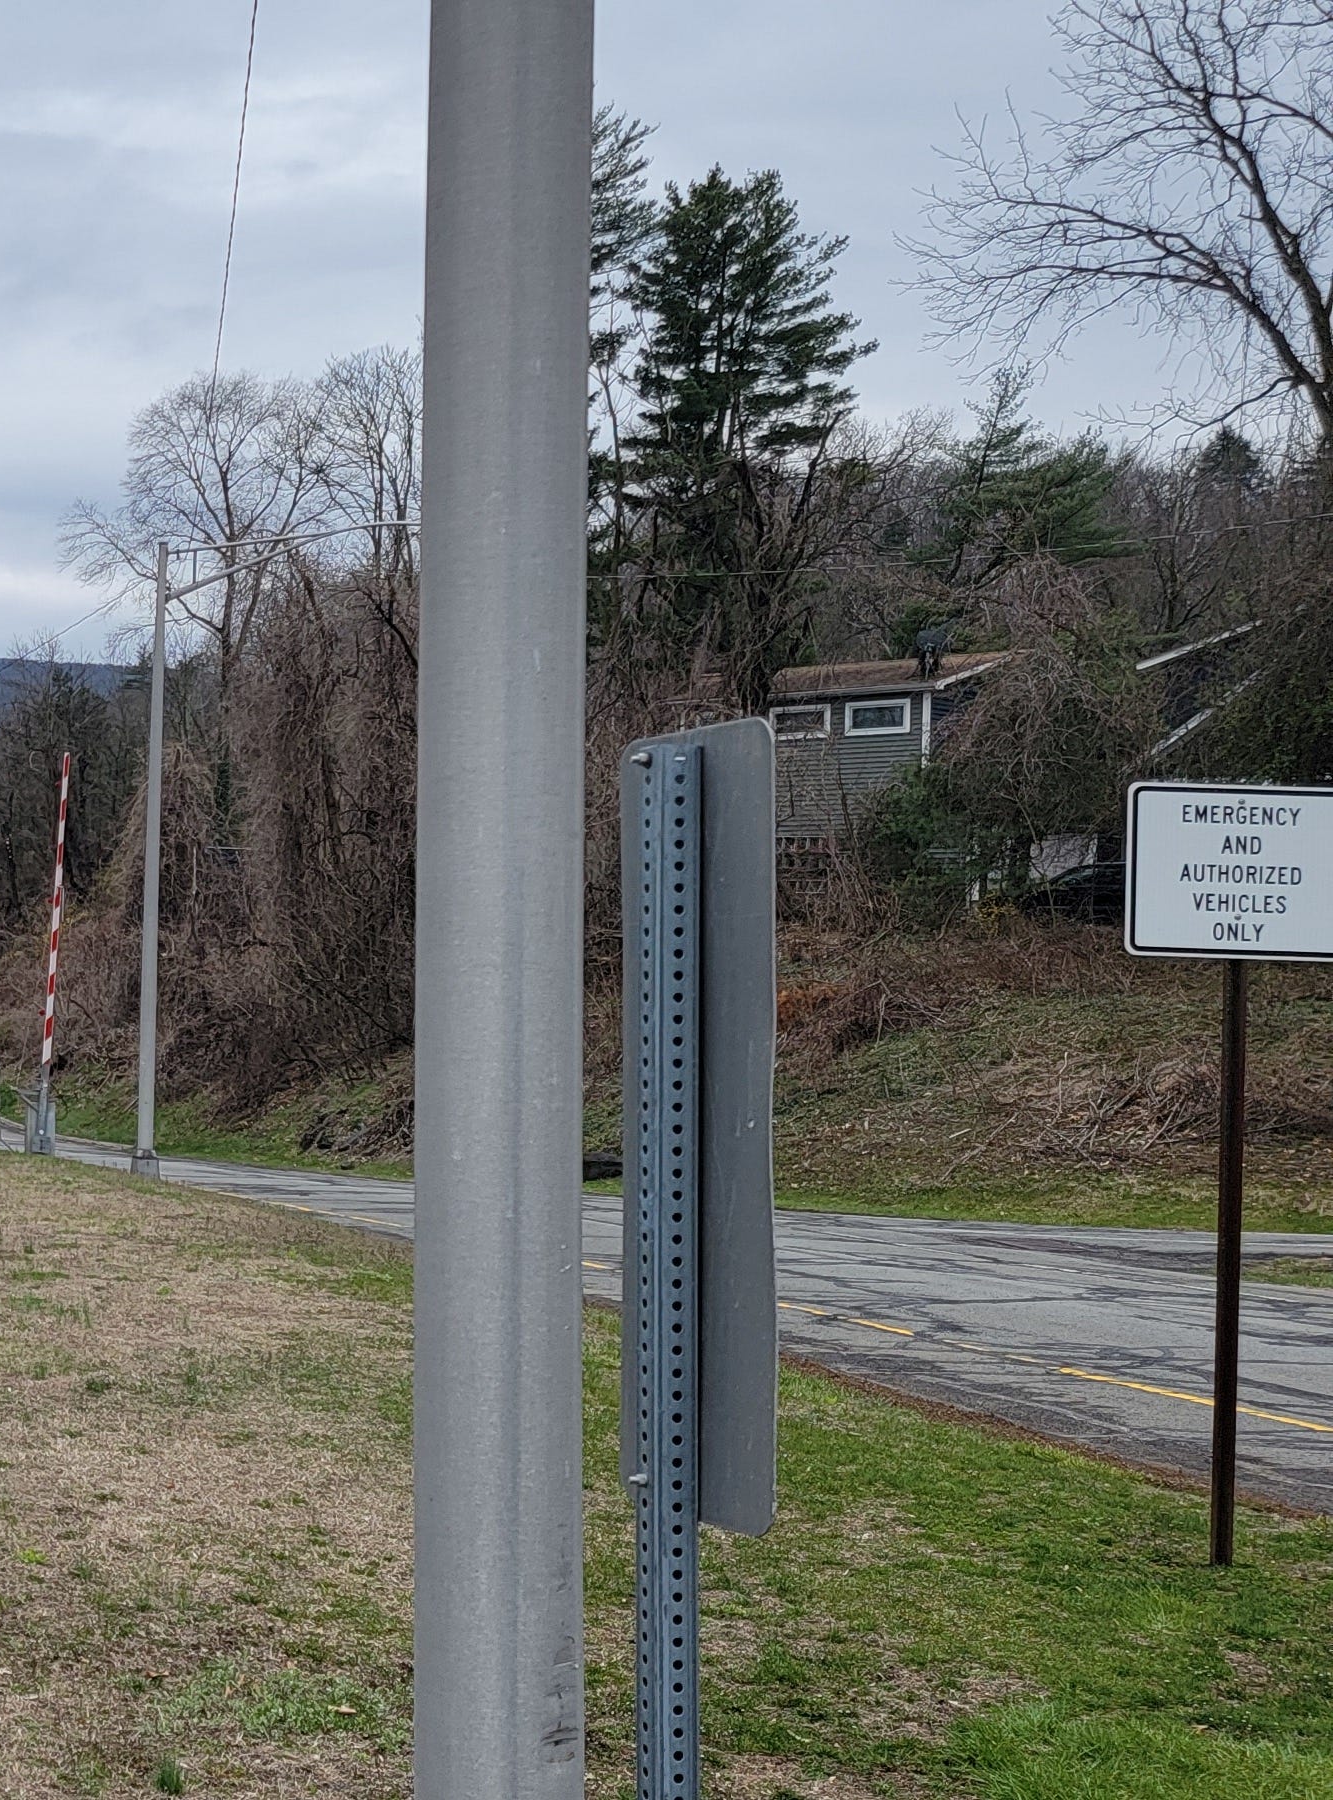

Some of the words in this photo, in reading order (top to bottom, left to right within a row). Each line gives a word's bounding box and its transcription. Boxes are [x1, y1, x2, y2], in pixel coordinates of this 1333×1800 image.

[1182, 805, 1301, 826] EMERGENCY
[1221, 835, 1262, 855] AND
[1180, 863, 1302, 885] AUTHORIZED
[1193, 893, 1287, 914] VEHICLES
[1213, 922, 1264, 942] ONLY
